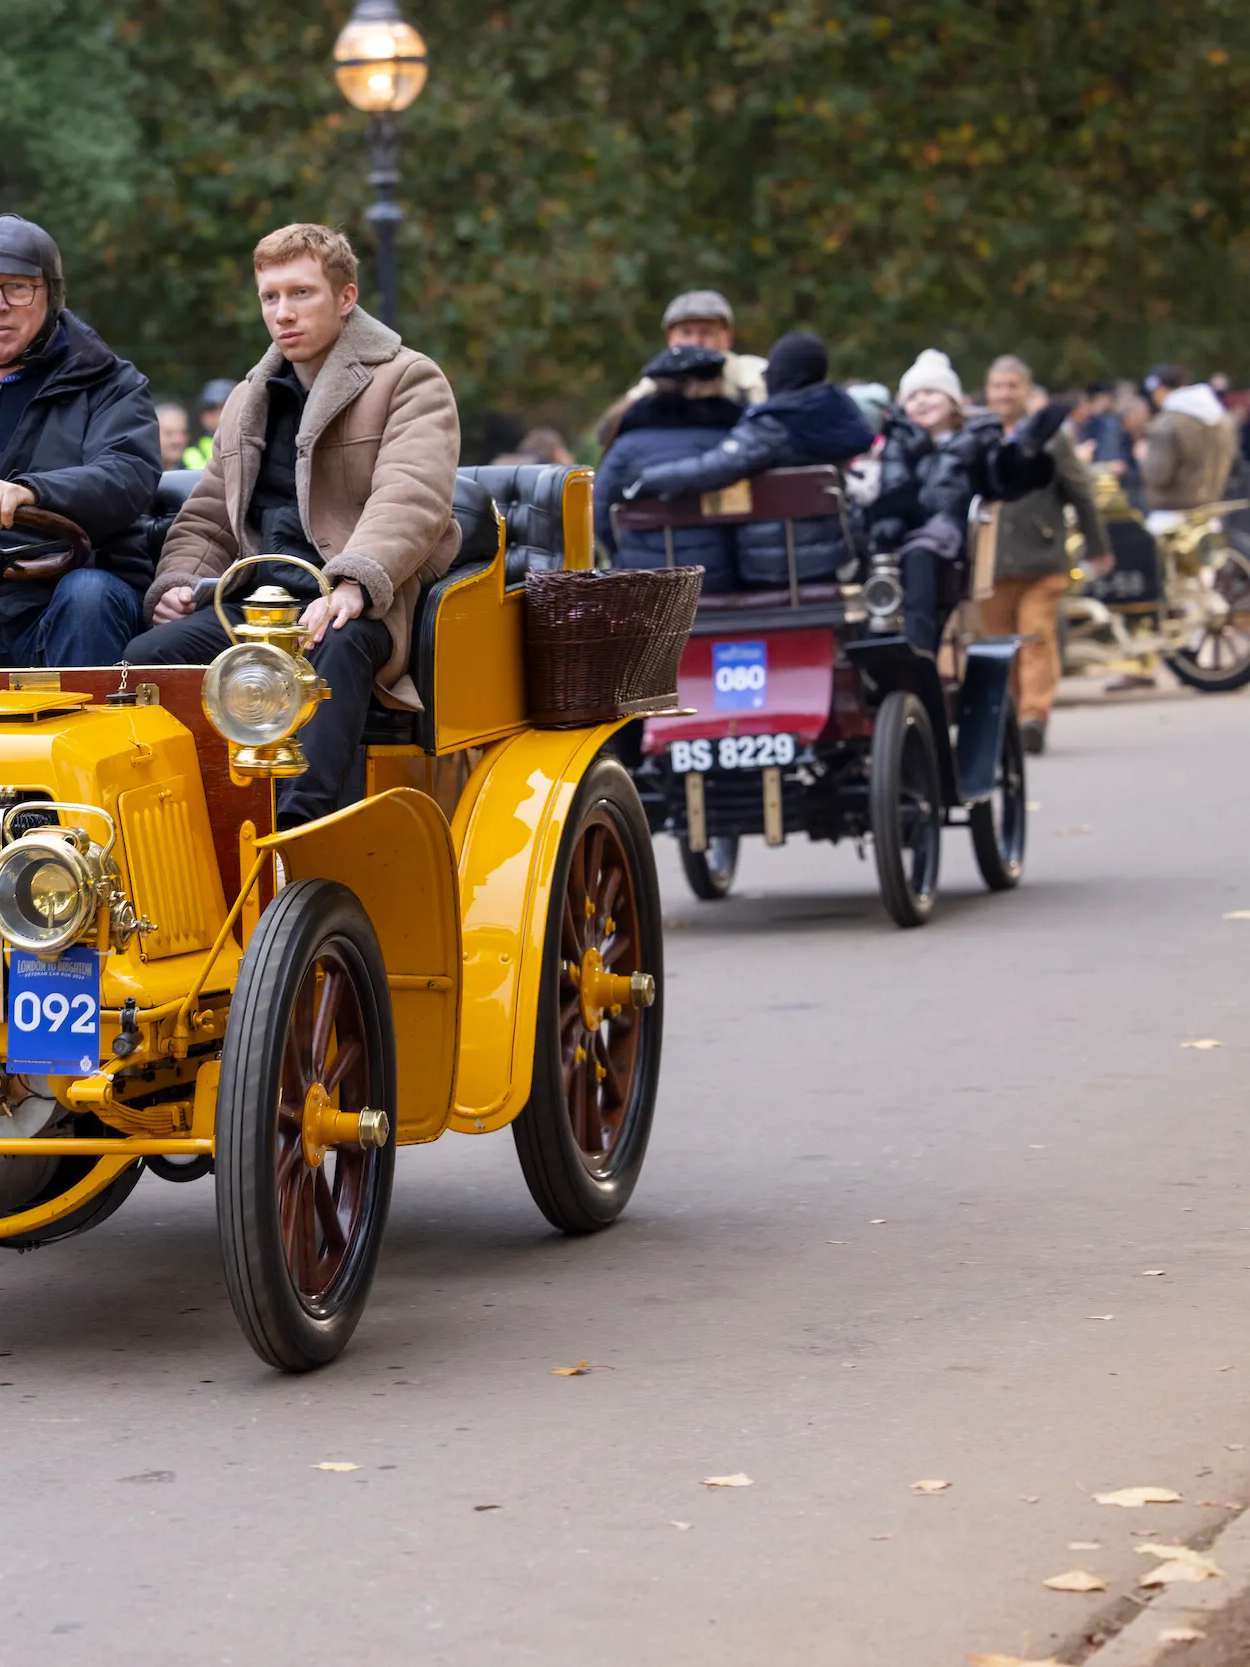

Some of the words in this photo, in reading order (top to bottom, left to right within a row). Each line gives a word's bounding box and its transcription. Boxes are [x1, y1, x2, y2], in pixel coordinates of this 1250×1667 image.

[671, 738, 713, 773] BS
[718, 732, 795, 770] 8229
[17, 960, 46, 974] LONDON
[47, 961, 56, 971] TO
[58, 961, 92, 976] BRIGHTON
[13, 991, 96, 1034] 092
